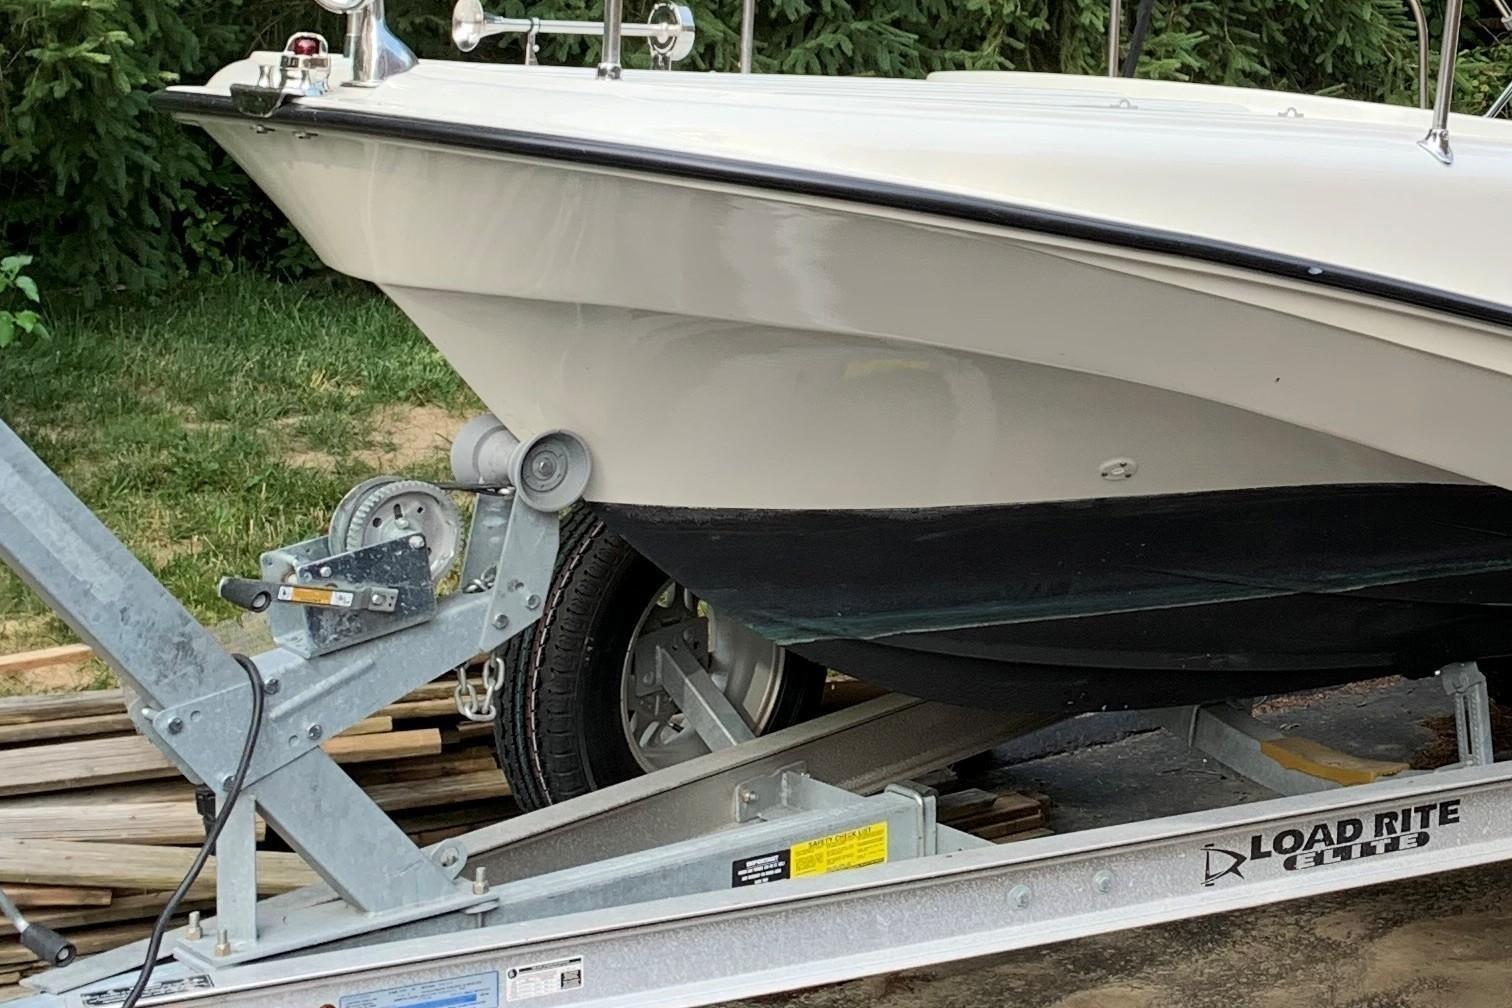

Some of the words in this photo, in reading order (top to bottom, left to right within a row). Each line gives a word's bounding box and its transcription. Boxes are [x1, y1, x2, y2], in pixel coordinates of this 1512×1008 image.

[1250, 818, 1363, 860] LOAD
[1374, 799, 1461, 838] RITE
[1294, 832, 1419, 870] ELITE
